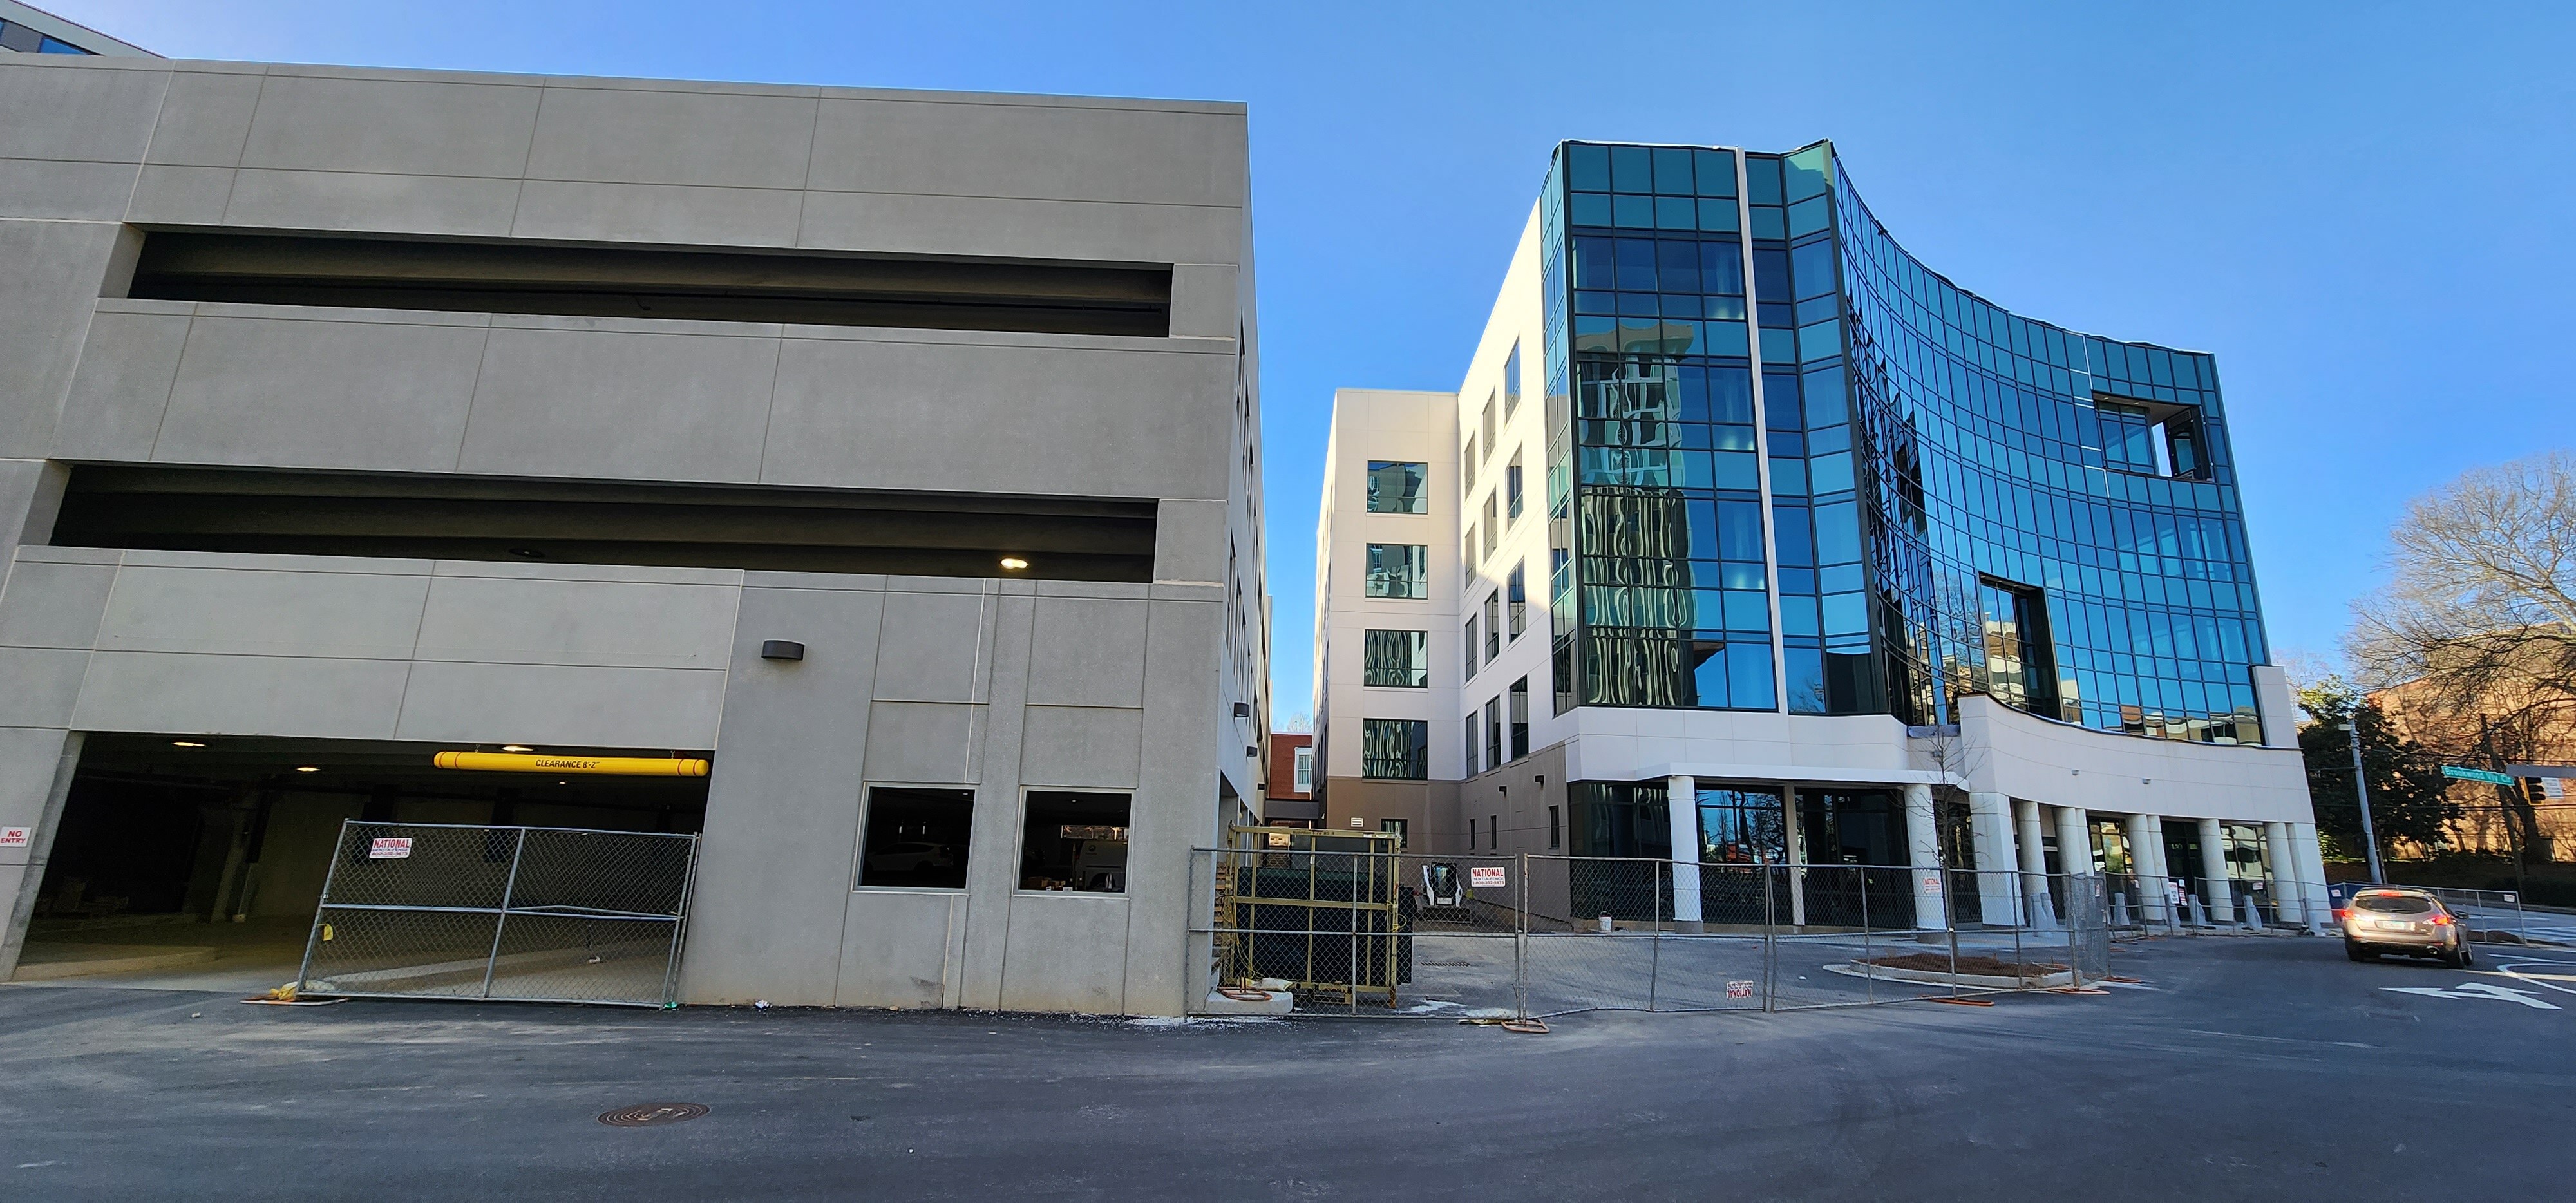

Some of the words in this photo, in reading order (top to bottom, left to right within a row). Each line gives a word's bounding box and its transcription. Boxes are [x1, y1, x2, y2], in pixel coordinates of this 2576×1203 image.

[536, 759, 581, 768] CLEARANCE
[2445, 768, 2485, 779] Brookwood
[374, 839, 410, 848] NATIONAL
